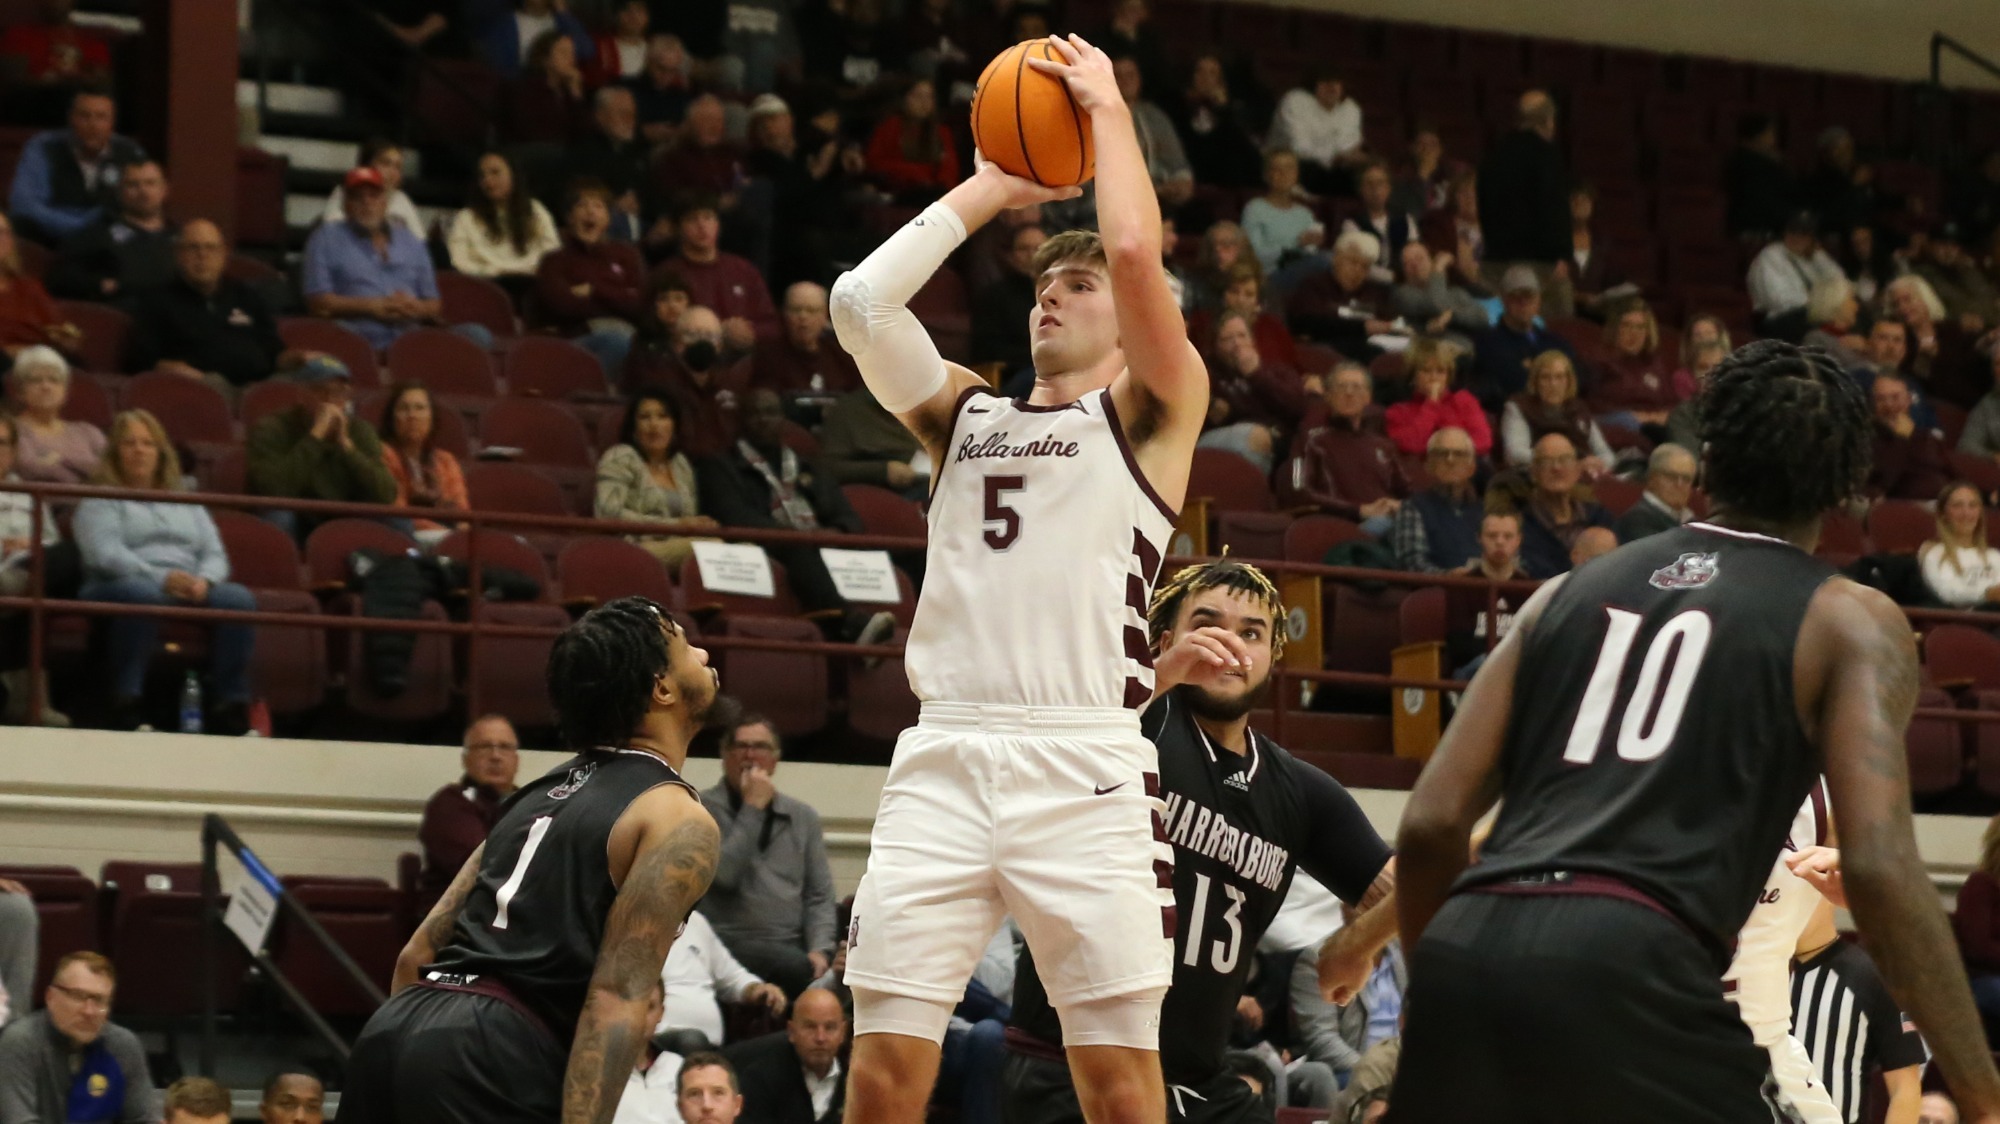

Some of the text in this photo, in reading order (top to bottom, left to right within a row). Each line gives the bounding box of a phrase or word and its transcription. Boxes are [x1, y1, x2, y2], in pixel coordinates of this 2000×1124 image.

[954, 431, 1080, 464] Bellarmine
[982, 474, 1027, 554] 5
[1563, 606, 1713, 764] 10
[1223, 779, 1249, 792] adidas
[492, 815, 553, 930] 1
[1183, 872, 1247, 975] 13
